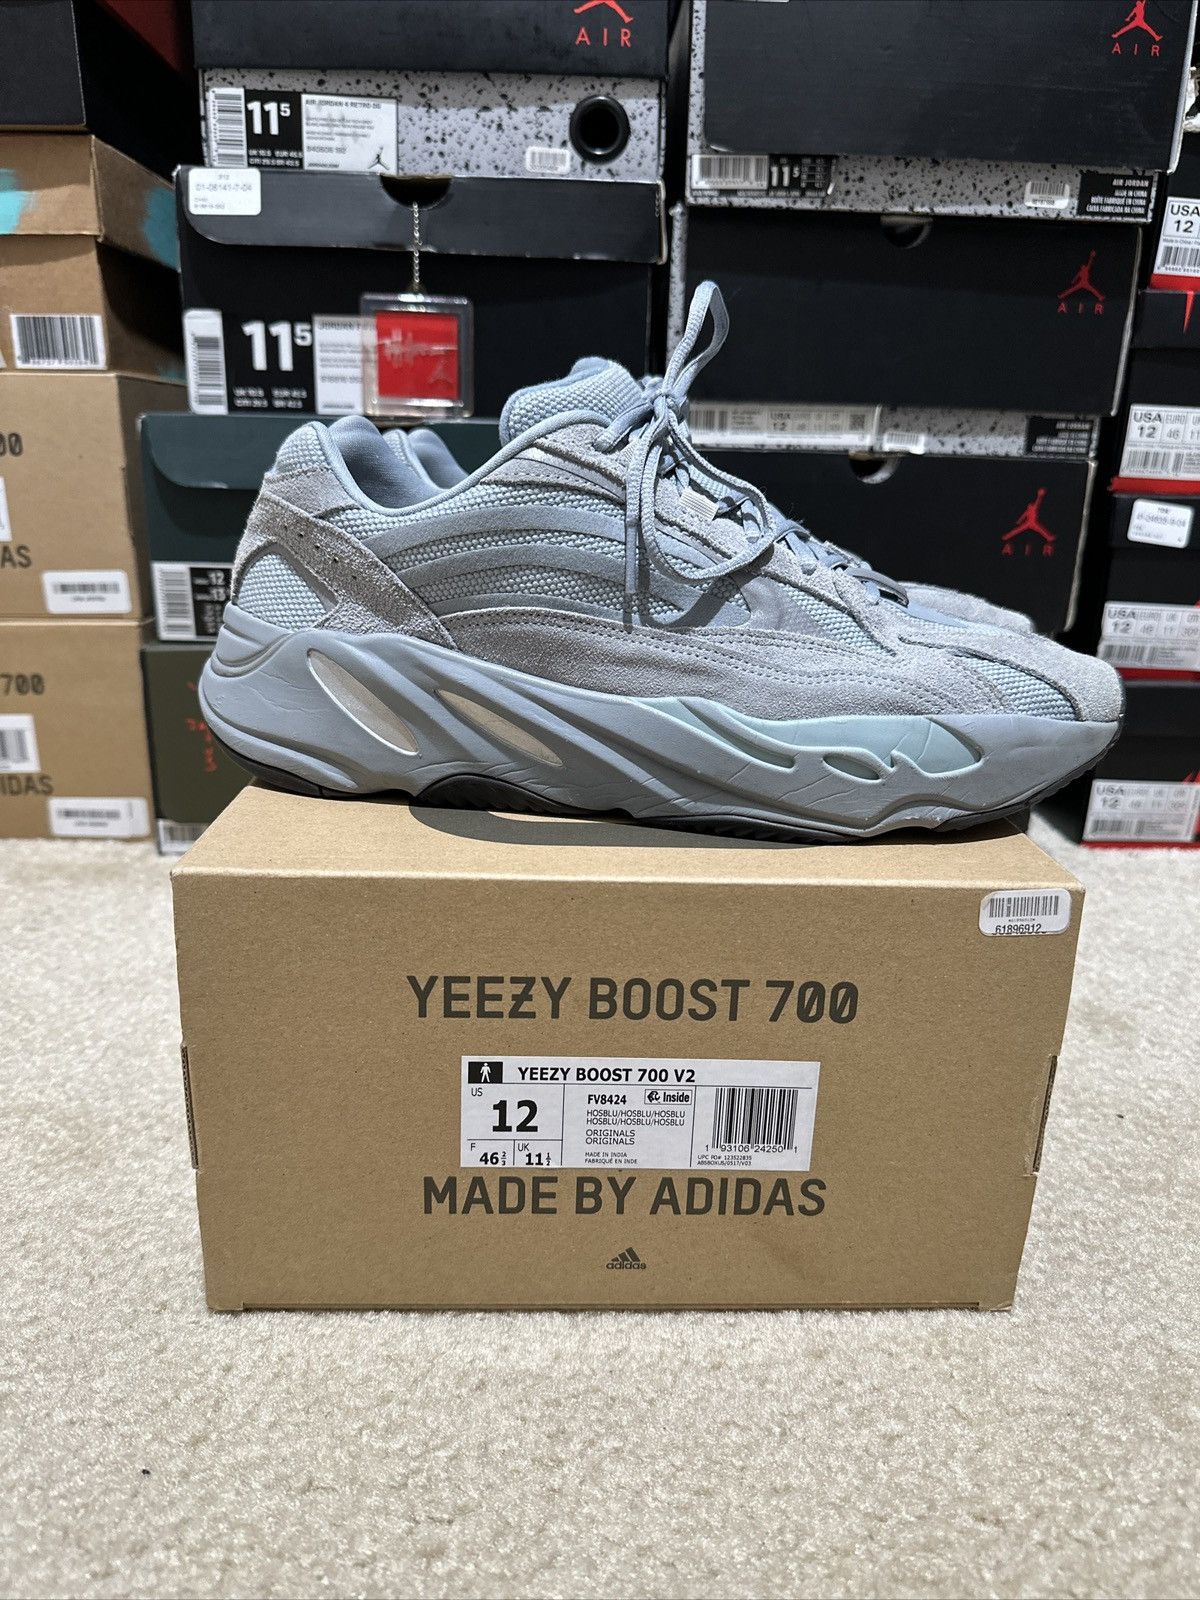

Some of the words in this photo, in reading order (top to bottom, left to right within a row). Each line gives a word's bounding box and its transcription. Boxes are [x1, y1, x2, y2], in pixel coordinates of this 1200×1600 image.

[575, 27, 631, 48] AIR
[1111, 43, 1161, 57] AIR
[1124, 179, 1149, 187] JORDAN
[1170, 203, 1200, 217] USA
[1174, 220, 1194, 233] 12
[1057, 302, 1104, 315] AIR
[1133, 412, 1162, 423] USA
[1138, 425, 1156, 438] 12
[1002, 543, 1054, 557] AIR
[1, 545, 31, 569] AS
[1107, 609, 1136, 620] USA
[1112, 620, 1132, 634] 12
[0, 673, 45, 696] 700
[1096, 785, 1124, 796] USA
[1101, 797, 1121, 809] 12
[994, 924, 1042, 934] 61896912
[407, 975, 572, 1020] YEEZY
[588, 977, 750, 1022] BOOST
[765, 980, 859, 1024] 700
[518, 1067, 570, 1081] YEEZY
[576, 1068, 632, 1082] BOOST
[638, 1069, 669, 1082] 700
[674, 1069, 696, 1083] V2
[471, 1087, 483, 1097] US
[663, 1091, 690, 1103] Inside
[587, 1094, 627, 1105] FV8424
[492, 1099, 539, 1132] 12
[586, 1109, 686, 1119] HOSBLU/HOSBLU/HOSBLU
[586, 1117, 685, 1127] HOSBLU/HOSBLU/HOSBLU
[585, 1129, 636, 1137] ORIGINALS
[470, 1143, 476, 1151] F
[517, 1143, 530, 1152] UK
[585, 1137, 635, 1146] ORIGINALS
[721, 1144, 750, 1152] 93106
[754, 1145, 784, 1153] 24250
[479, 1152, 499, 1165] 46
[525, 1153, 543, 1166] 11
[423, 1175, 557, 1215] MADE
[575, 1176, 636, 1215] BY
[649, 1177, 827, 1217] ADIDAS
[606, 1260, 646, 1270] adidas
